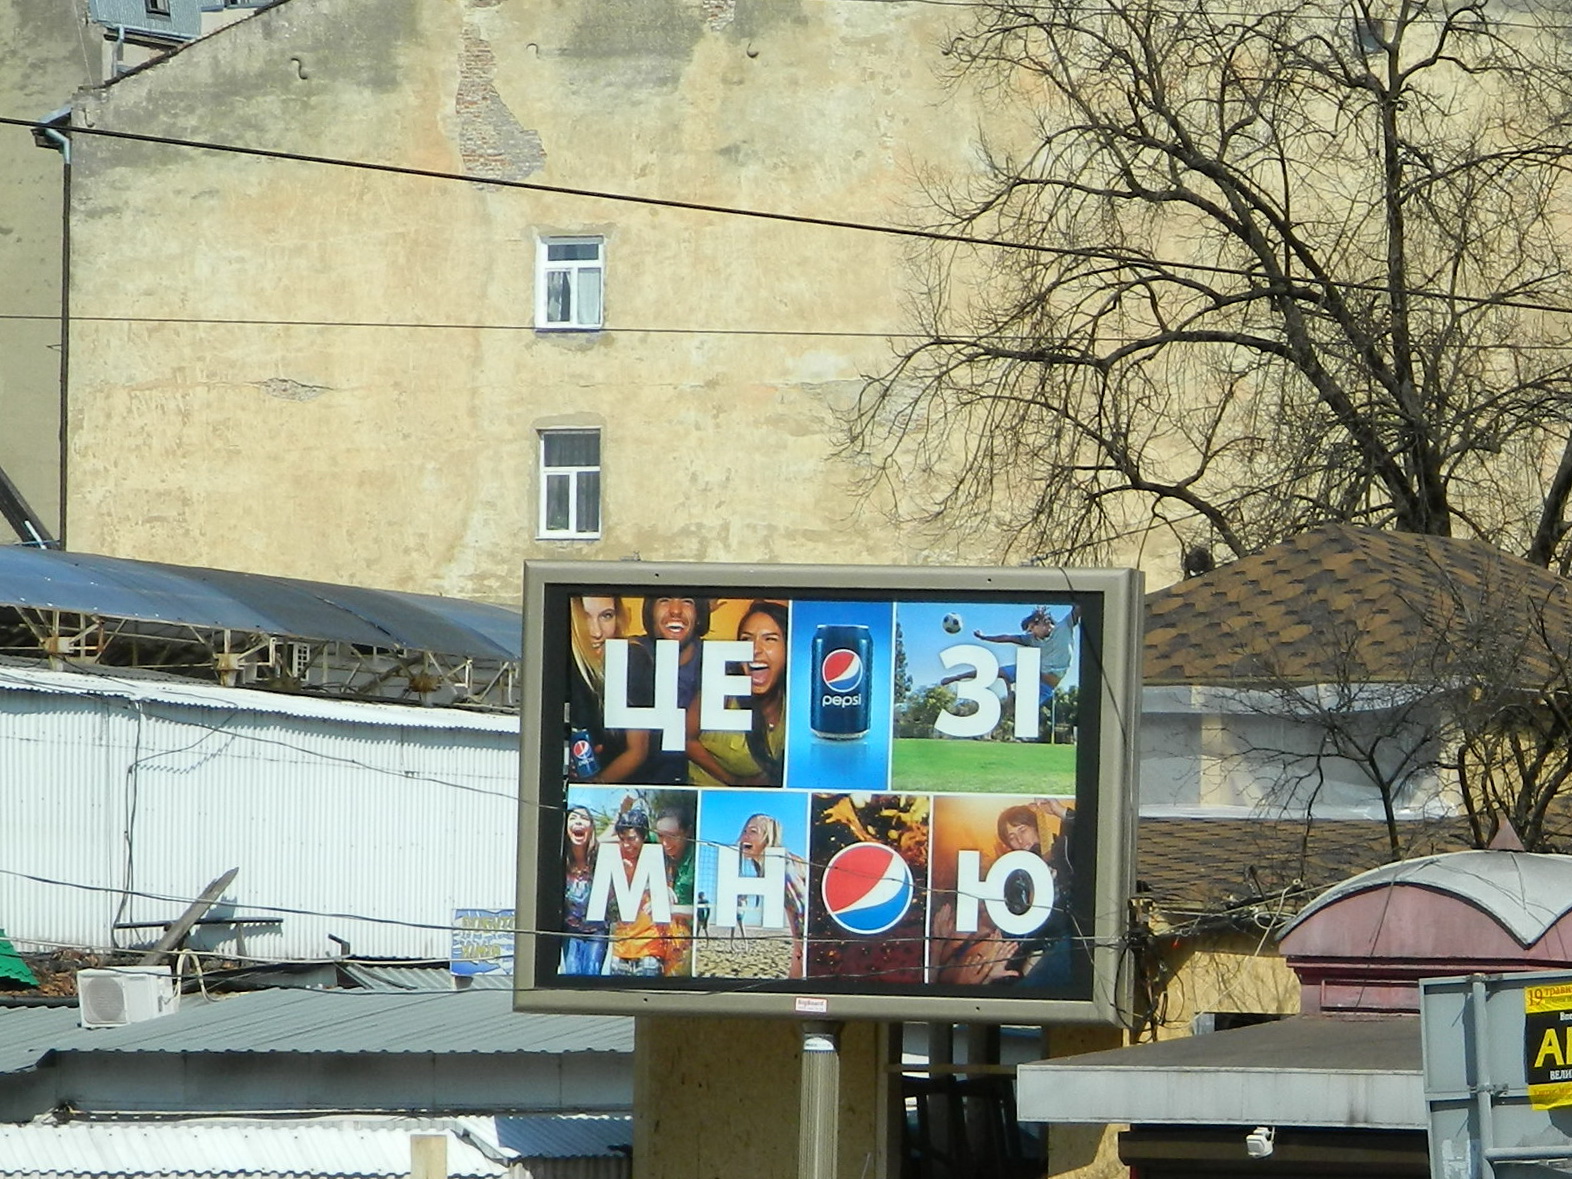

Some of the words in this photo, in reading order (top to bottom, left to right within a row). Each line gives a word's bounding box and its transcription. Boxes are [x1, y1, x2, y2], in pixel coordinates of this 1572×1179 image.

[603, 639, 754, 752] ЦЕ
[934, 644, 1041, 739] ЗІ
[822, 693, 861, 708] pepsi
[1528, 988, 1543, 1006] 19
